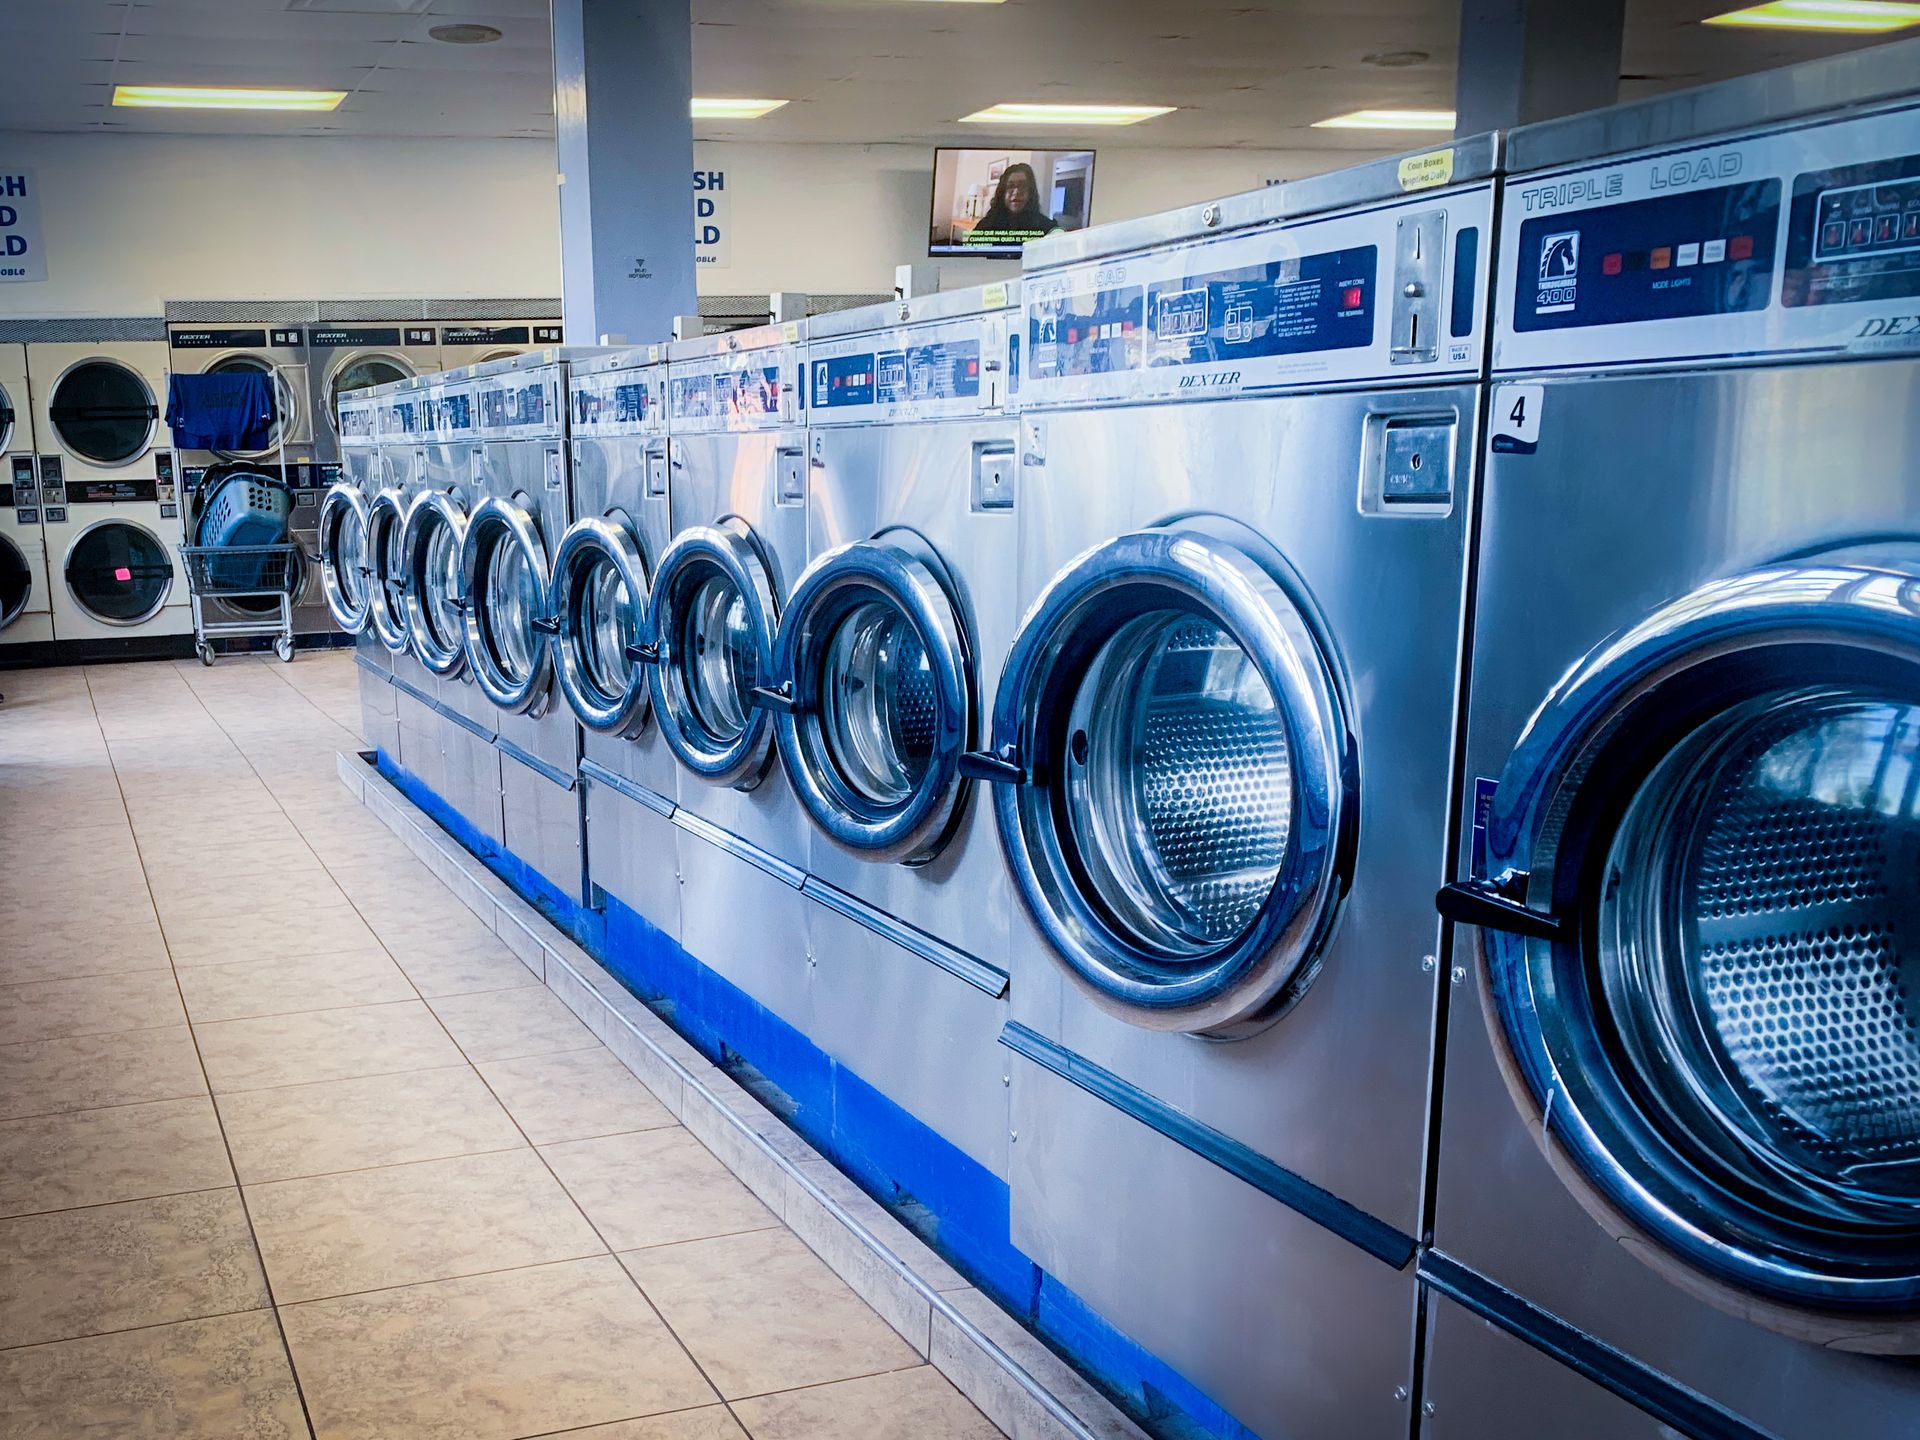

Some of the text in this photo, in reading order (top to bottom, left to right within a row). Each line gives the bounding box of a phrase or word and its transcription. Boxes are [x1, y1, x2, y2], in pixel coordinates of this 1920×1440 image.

[1407, 157, 1444, 171] Coin Boxes
[1430, 170, 1447, 181] Daily
[1522, 152, 1742, 211] TRIPLE LOAD
[1087, 267, 1126, 288] LOAD
[1652, 278, 1691, 289] MODE LIGHTS
[1536, 287, 1577, 305] 400
[1452, 353, 1466, 361] USA
[1178, 372, 1241, 387] DEXTER
[1510, 396, 1525, 428] 4
[815, 437, 821, 454] 6
